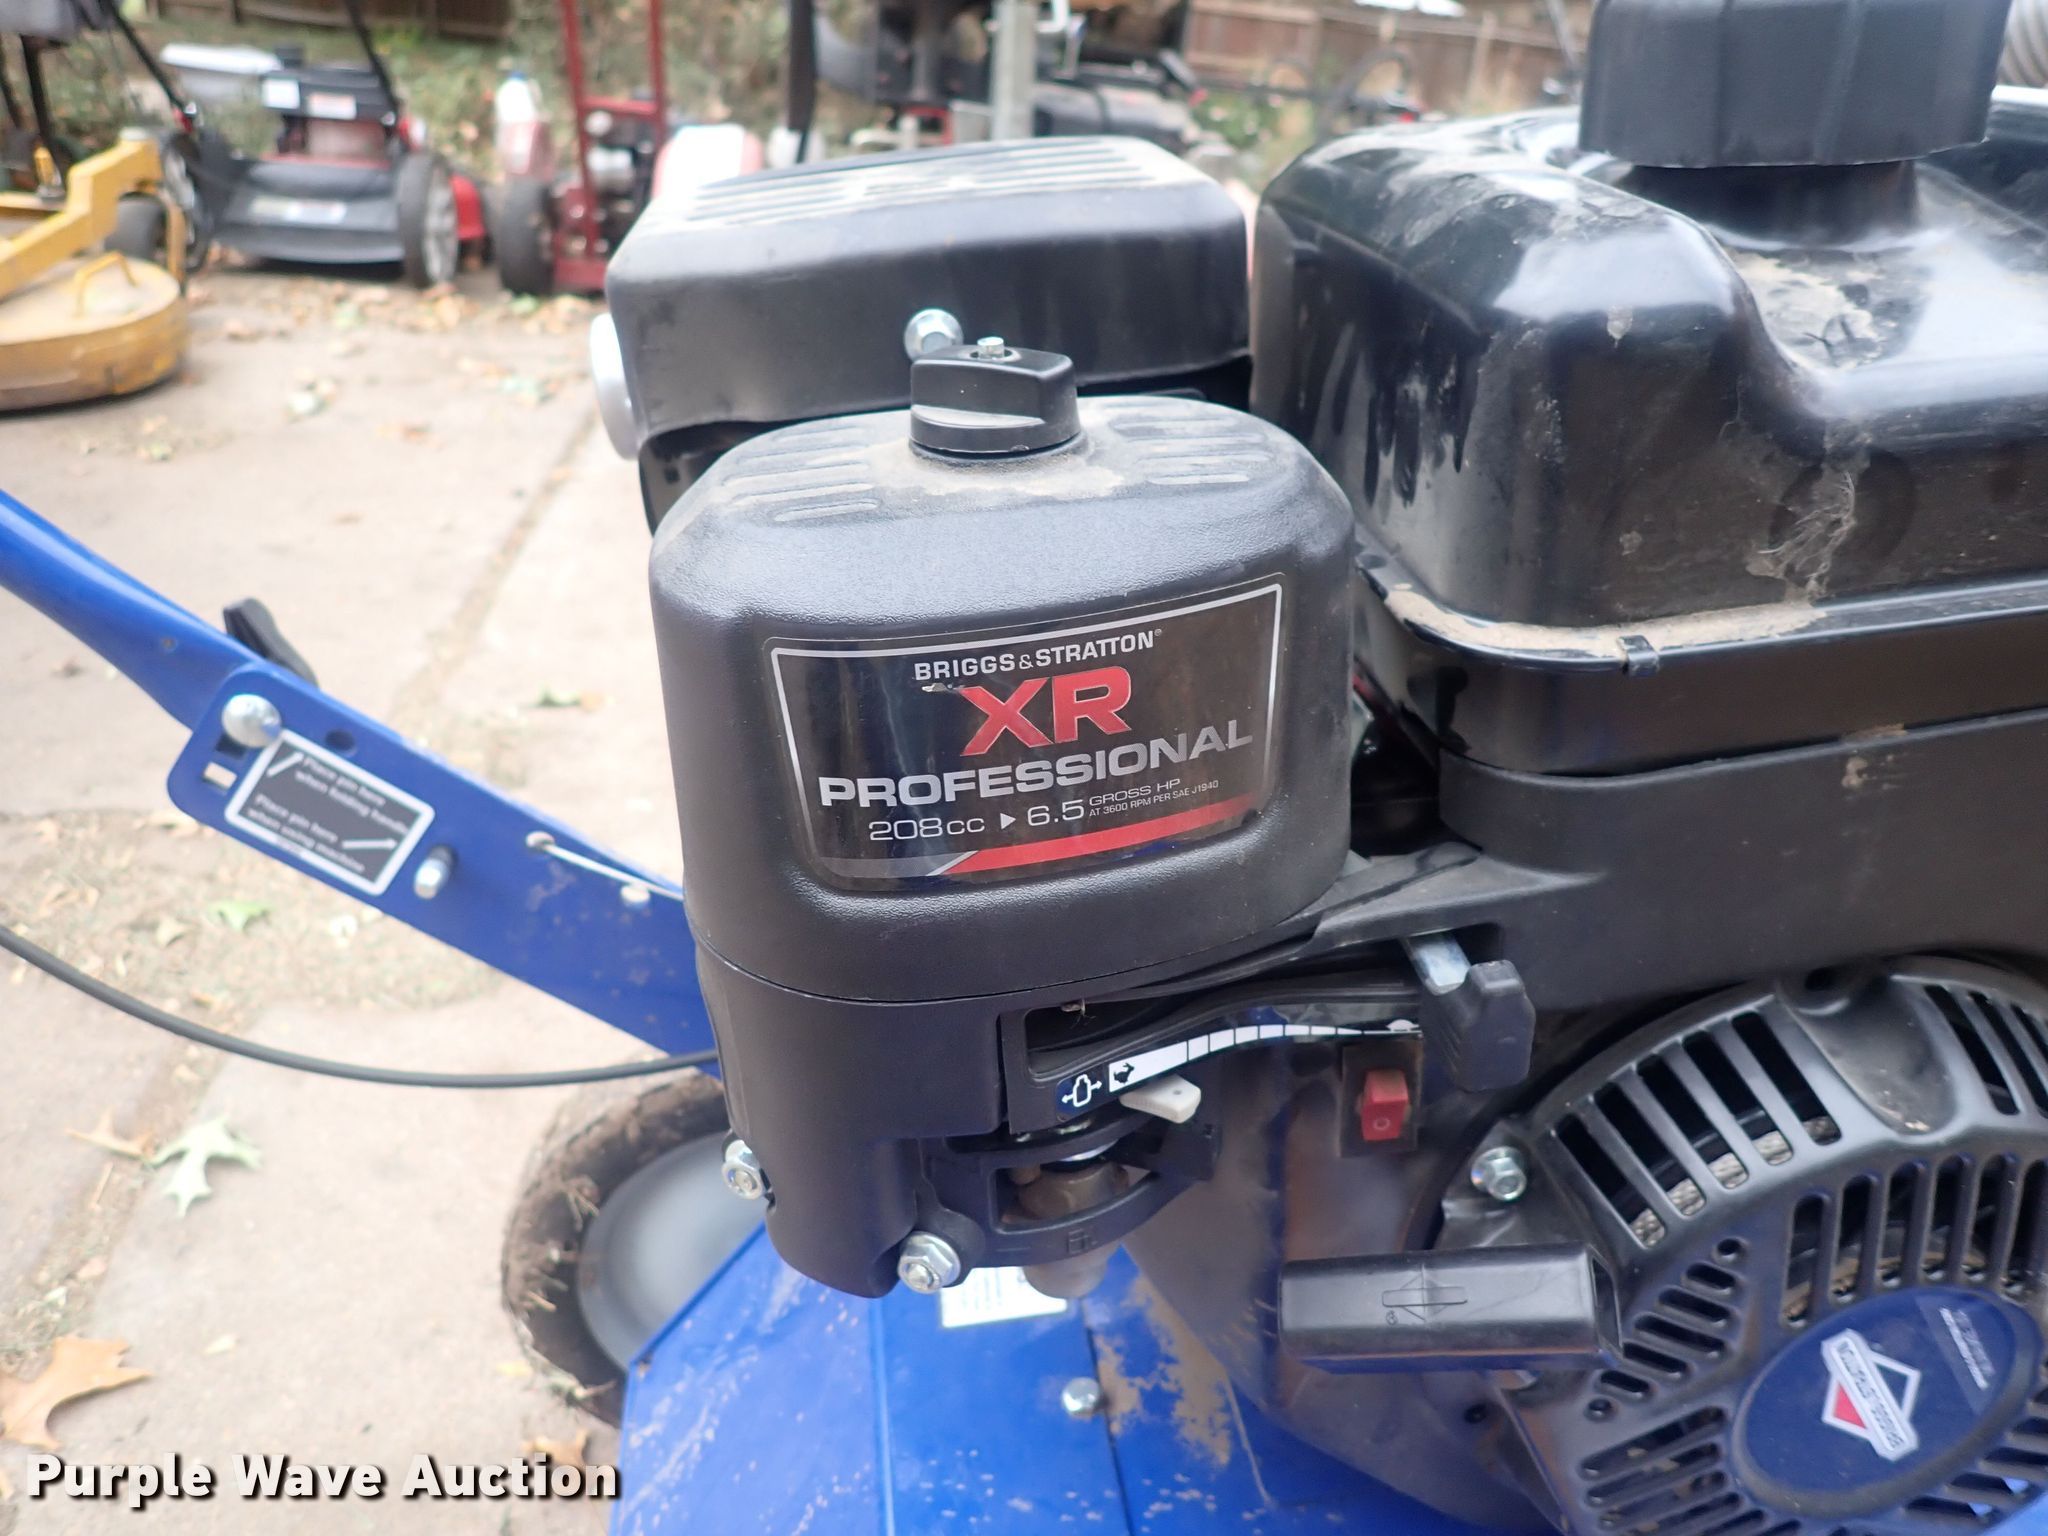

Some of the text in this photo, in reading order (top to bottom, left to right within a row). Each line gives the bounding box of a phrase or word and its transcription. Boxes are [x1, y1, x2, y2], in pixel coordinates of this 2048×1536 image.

[959, 665, 1132, 757] XR
[818, 719, 1253, 808] PROFESSIONAL
[1089, 778, 1181, 806] GROSS HP
[1089, 780, 1219, 817] AT 3600 RPM PER SAE J1940
[1027, 798, 1085, 827] 6.5
